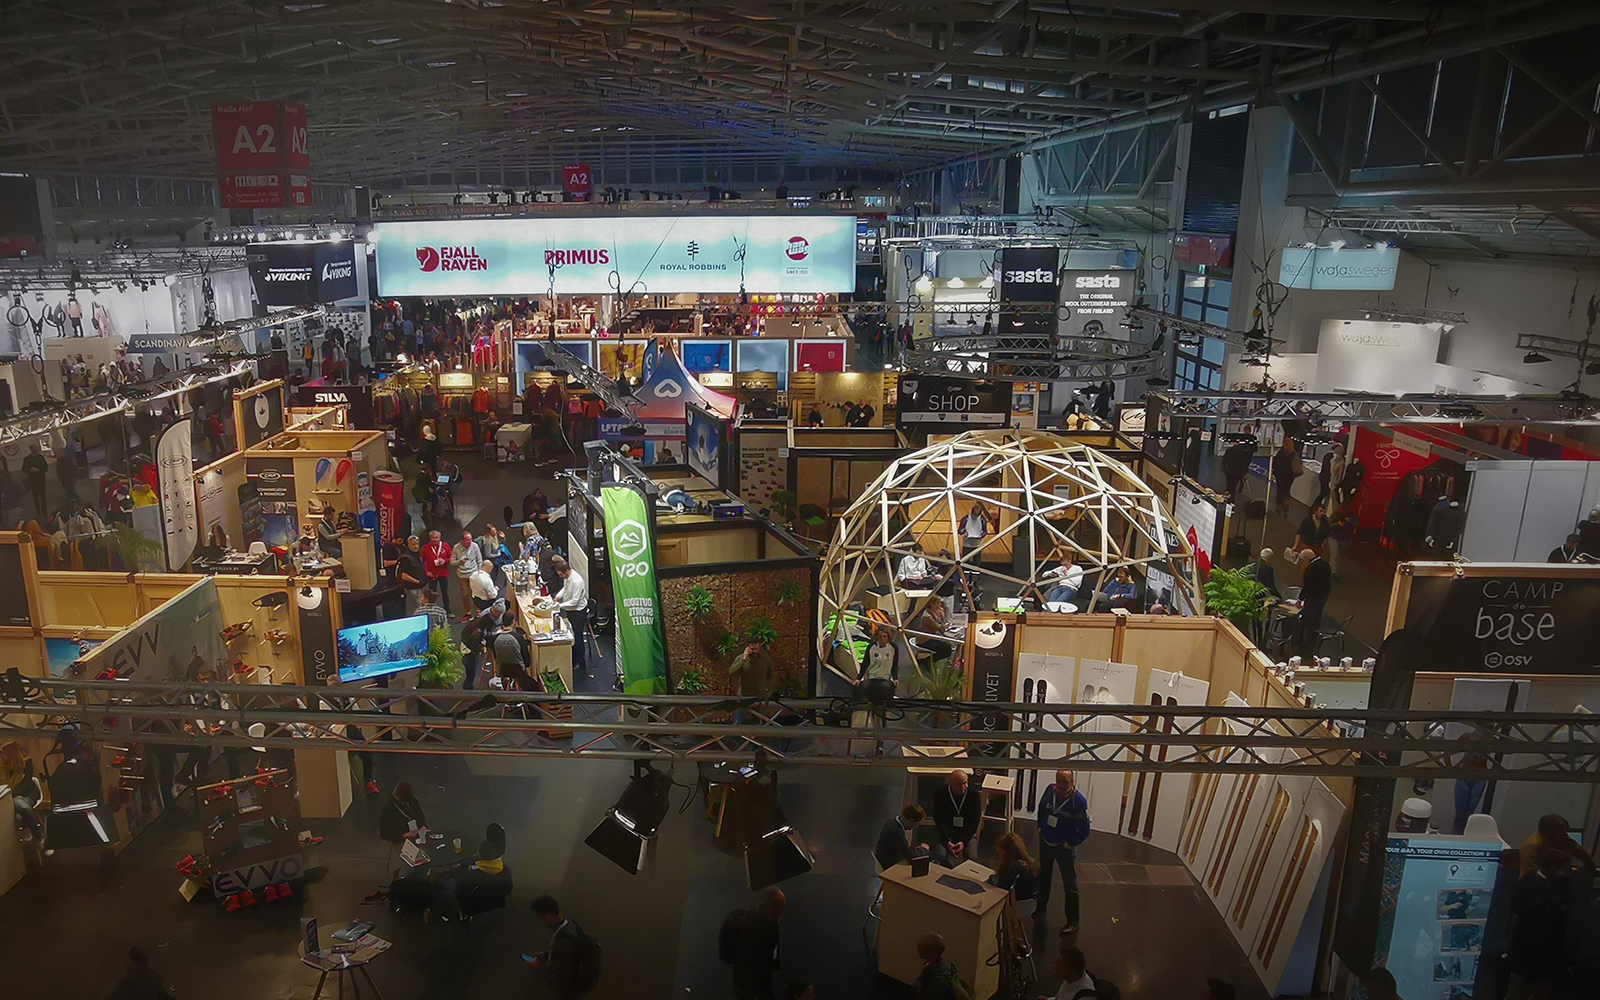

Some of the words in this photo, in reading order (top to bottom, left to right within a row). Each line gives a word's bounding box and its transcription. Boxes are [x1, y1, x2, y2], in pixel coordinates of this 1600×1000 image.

[232, 124, 276, 154] A2
[292, 125, 308, 155] A2
[569, 172, 588, 185] A2
[544, 249, 610, 265] PRIMUS
[271, 273, 312, 282] VIKING
[330, 266, 352, 280] VIKING
[1004, 267, 1054, 283] sasta
[1075, 274, 1121, 288] sasta
[314, 392, 349, 403] SILVA
[928, 395, 980, 412] SHOP
[1482, 580, 1564, 600] CAMP
[1512, 602, 1527, 611] de
[1475, 606, 1556, 647] base
[314, 649, 328, 680] EVVO
[985, 672, 999, 703] LIVET
[215, 857, 301, 894] EVVO
